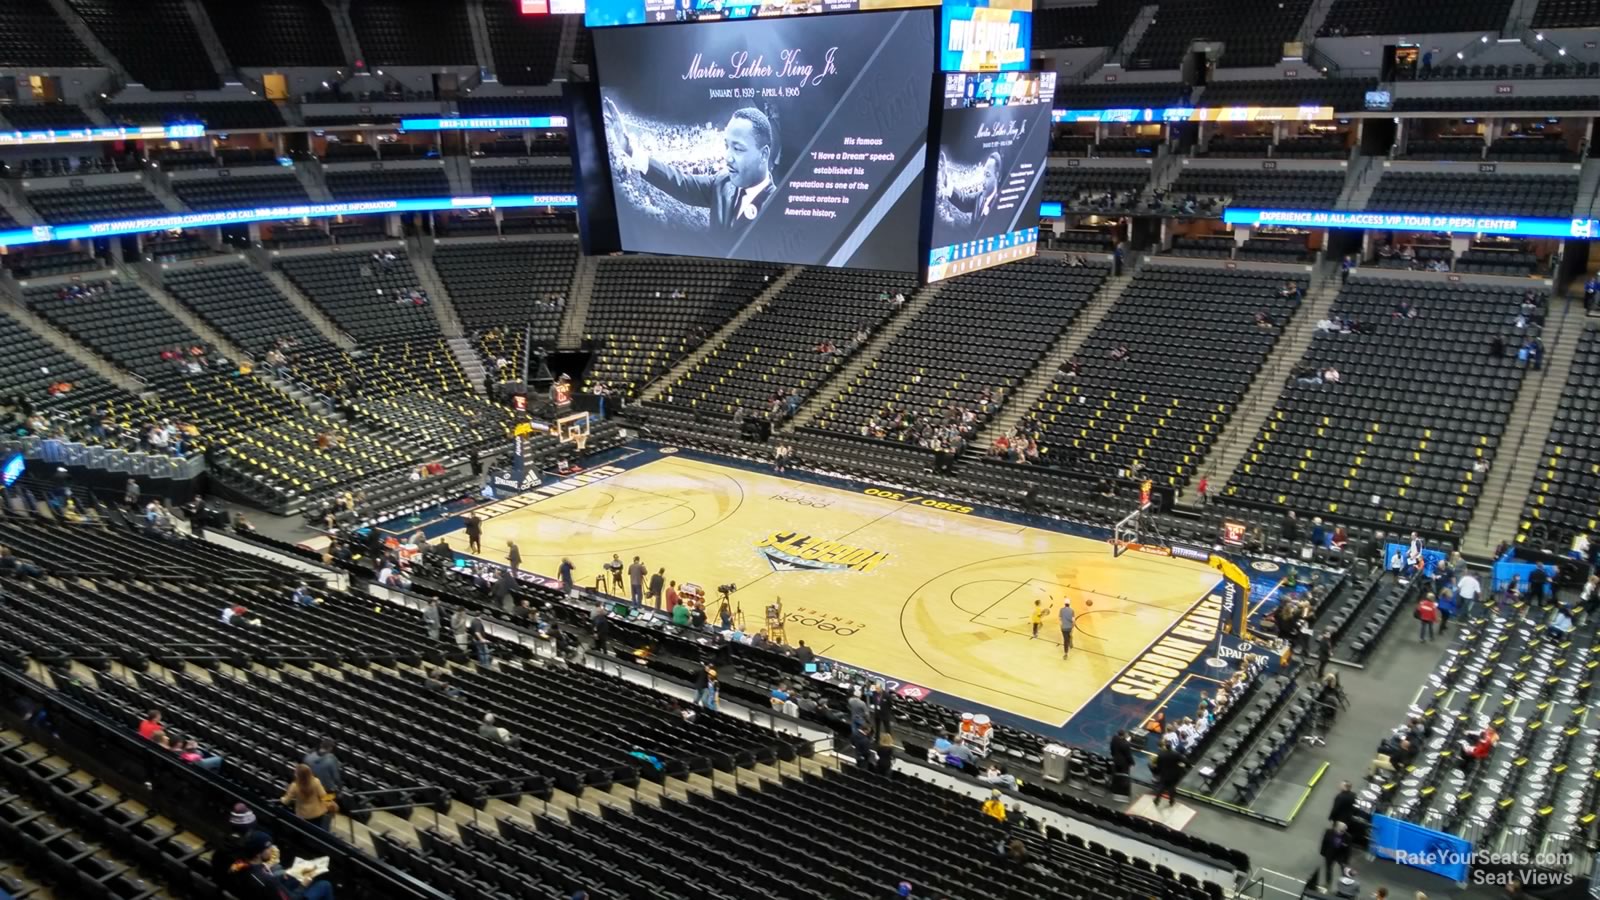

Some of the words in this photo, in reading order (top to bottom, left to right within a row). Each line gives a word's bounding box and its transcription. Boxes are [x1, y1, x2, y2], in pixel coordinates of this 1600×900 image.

[682, 53, 725, 80] Martin
[728, 51, 772, 79] Luther
[776, 49, 813, 87] King
[812, 47, 838, 86] Jr.
[709, 88, 732, 99] JANUARY
[742, 87, 755, 98] 1929
[761, 87, 778, 97] APRIL
[844, 137, 855, 145] His
[856, 137, 883, 145] famous
[818, 152, 835, 160] Have
[870, 153, 895, 162] speech
[813, 167, 852, 175] established
[853, 167, 865, 175] his
[789, 181, 824, 189] reputation
[848, 182, 857, 190] of
[857, 182, 869, 190] the
[534, 195, 571, 204] EXPERIENCE
[788, 194, 815, 203] greatest
[842, 196, 849, 204] in
[90, 223, 110, 233] VISIT
[227, 210, 237, 220] OR
[238, 208, 255, 219] CALL
[310, 205, 326, 214] FOR
[327, 203, 349, 212] MORE
[348, 200, 397, 210] INFORMATION
[784, 208, 811, 216] America
[812, 208, 837, 218] history.
[1260, 211, 1312, 222] EXPERIENCE
[1313, 213, 1328, 222] AN
[1329, 213, 1384, 225] ALL-ACCESS
[1386, 215, 1401, 225] VIP
[1404, 216, 1432, 226] TOUR
[1433, 217, 1447, 227] OF
[1449, 217, 1475, 228] PEPSI
[1477, 219, 1517, 230] CENTER
[521, 479, 542, 490] adidas
[863, 488, 904, 501] 300
[921, 499, 974, 514] 5280
[752, 530, 894, 573] NUGGETS
[1223, 582, 1236, 613] xfinity
[784, 612, 860, 636] pepsi
[798, 607, 866, 628] CENTER
[1219, 645, 1269, 666] SPALNG
[1111, 636, 1207, 701] NUGGETS
